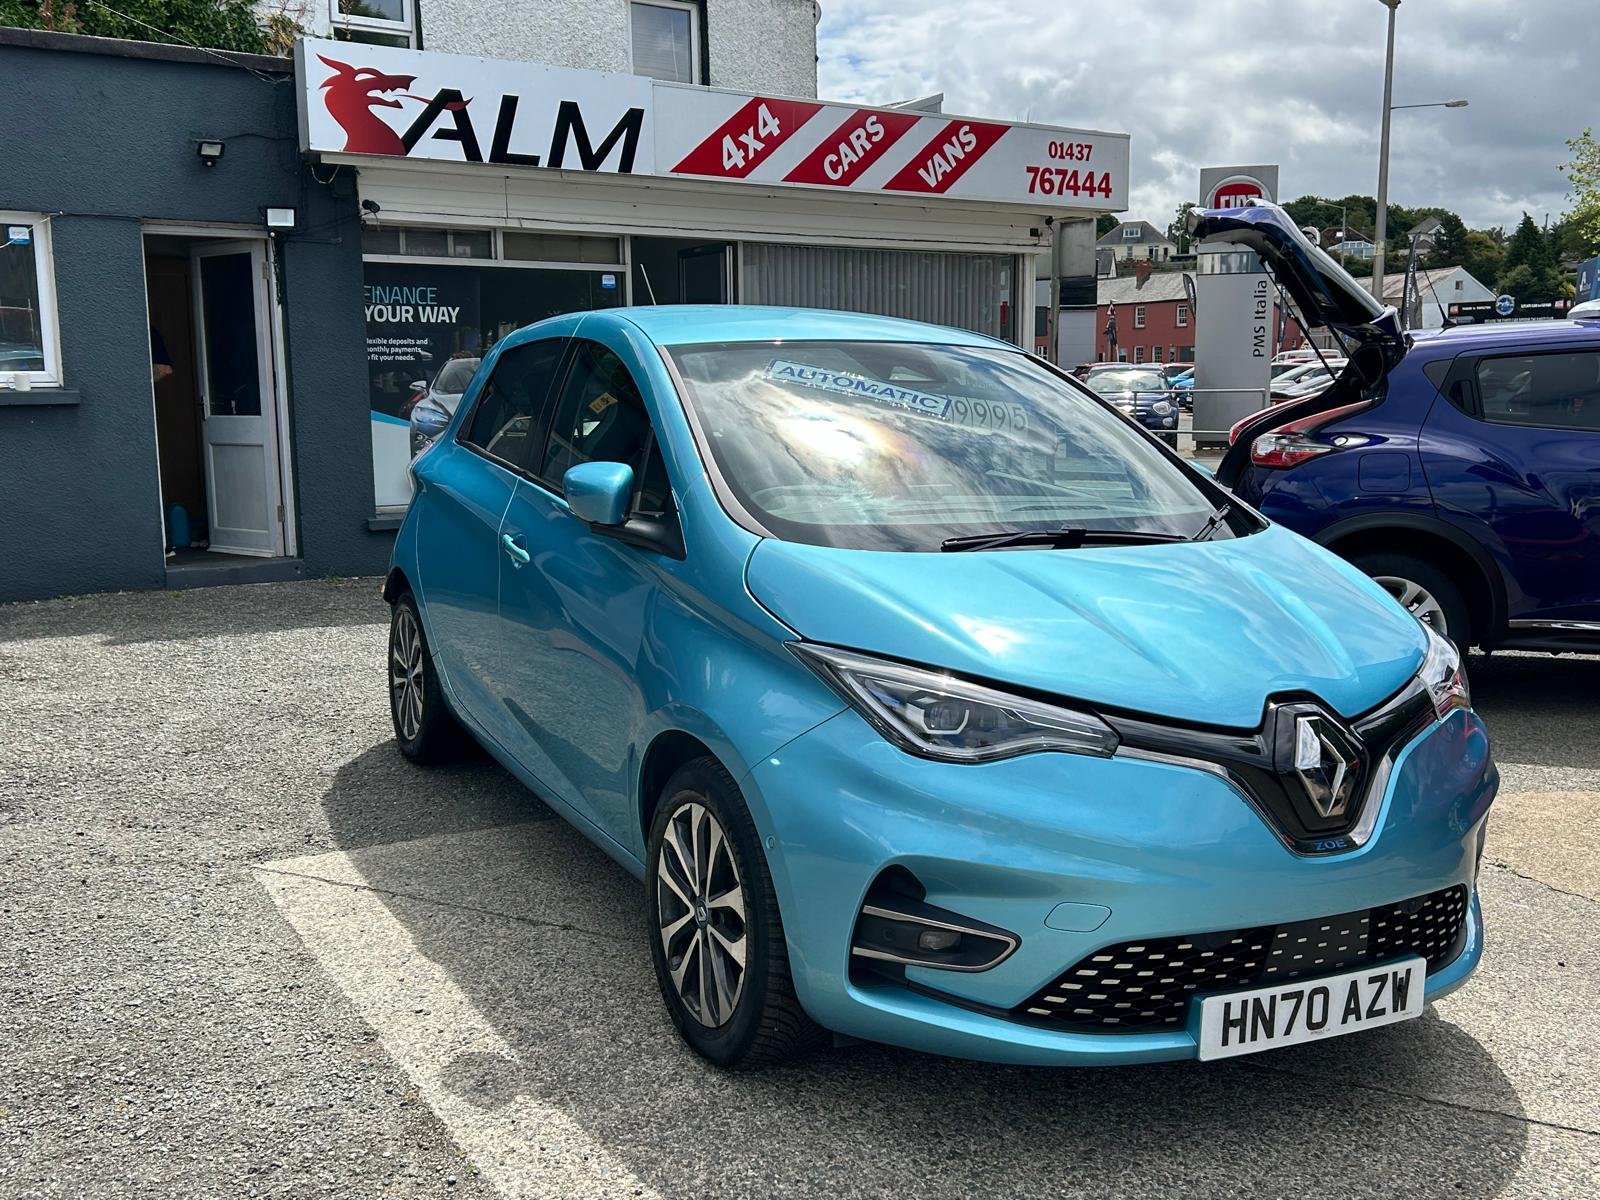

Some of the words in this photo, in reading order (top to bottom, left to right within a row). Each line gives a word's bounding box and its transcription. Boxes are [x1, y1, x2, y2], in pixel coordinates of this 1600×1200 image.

[403, 88, 645, 174] ALM
[721, 103, 780, 172] 4x4
[823, 115, 885, 181] CARS
[917, 125, 977, 188] VANS
[1048, 141, 1093, 162] 01437
[1025, 166, 1113, 198] 767444
[365, 305, 414, 323] YOUR
[418, 306, 460, 324] WAY
[1253, 280, 1267, 320] Italia
[367, 346, 390, 354] onthly
[388, 338, 415, 346] deposits
[1253, 326, 1265, 358] PMS
[379, 355, 394, 363] your
[776, 365, 941, 410] AUTOMATIC
[954, 400, 1026, 431] 9995
[1313, 839, 1345, 851] ZOE
[1221, 985, 1329, 1047] HN70
[1340, 967, 1412, 1026] AZW
